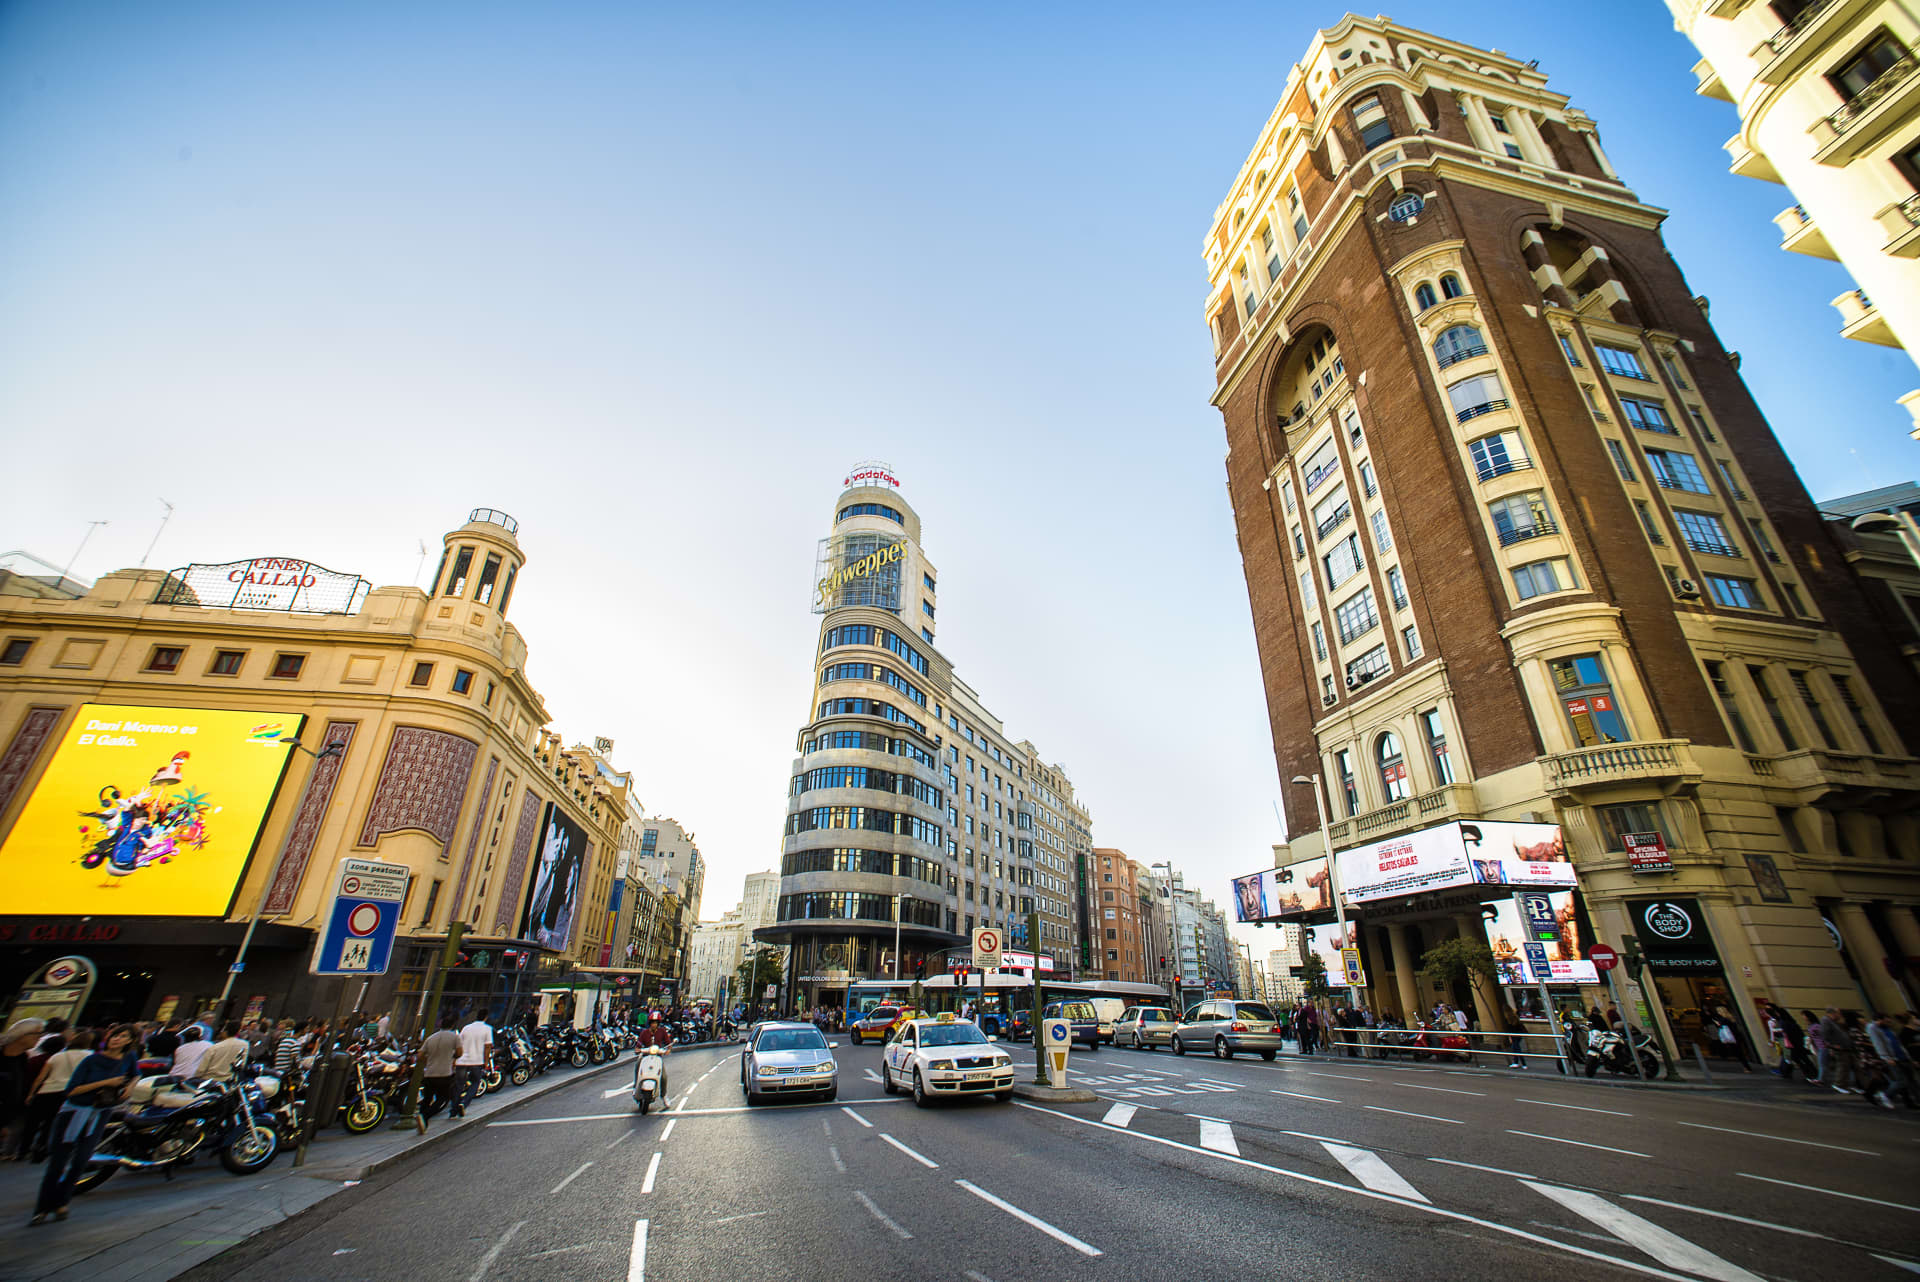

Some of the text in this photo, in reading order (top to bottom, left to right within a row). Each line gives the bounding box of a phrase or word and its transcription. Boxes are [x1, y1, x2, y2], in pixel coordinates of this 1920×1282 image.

[853, 470, 900, 487] vodafone
[254, 558, 304, 571] CINES
[228, 569, 316, 588] CALLAO
[816, 539, 908, 605] Schweppes
[86, 719, 198, 734] Dani Moreno es
[78, 734, 138, 746] El Gallo.
[472, 781, 513, 924] CALLAO
[370, 866, 404, 876] peatonal
[1655, 919, 1683, 927] BODY
[1658, 925, 1685, 933] SHOP
[28, 924, 121, 941] CALLAO
[1669, 959, 1692, 967] BODY
[1068, 1073, 1165, 1086] BUS
